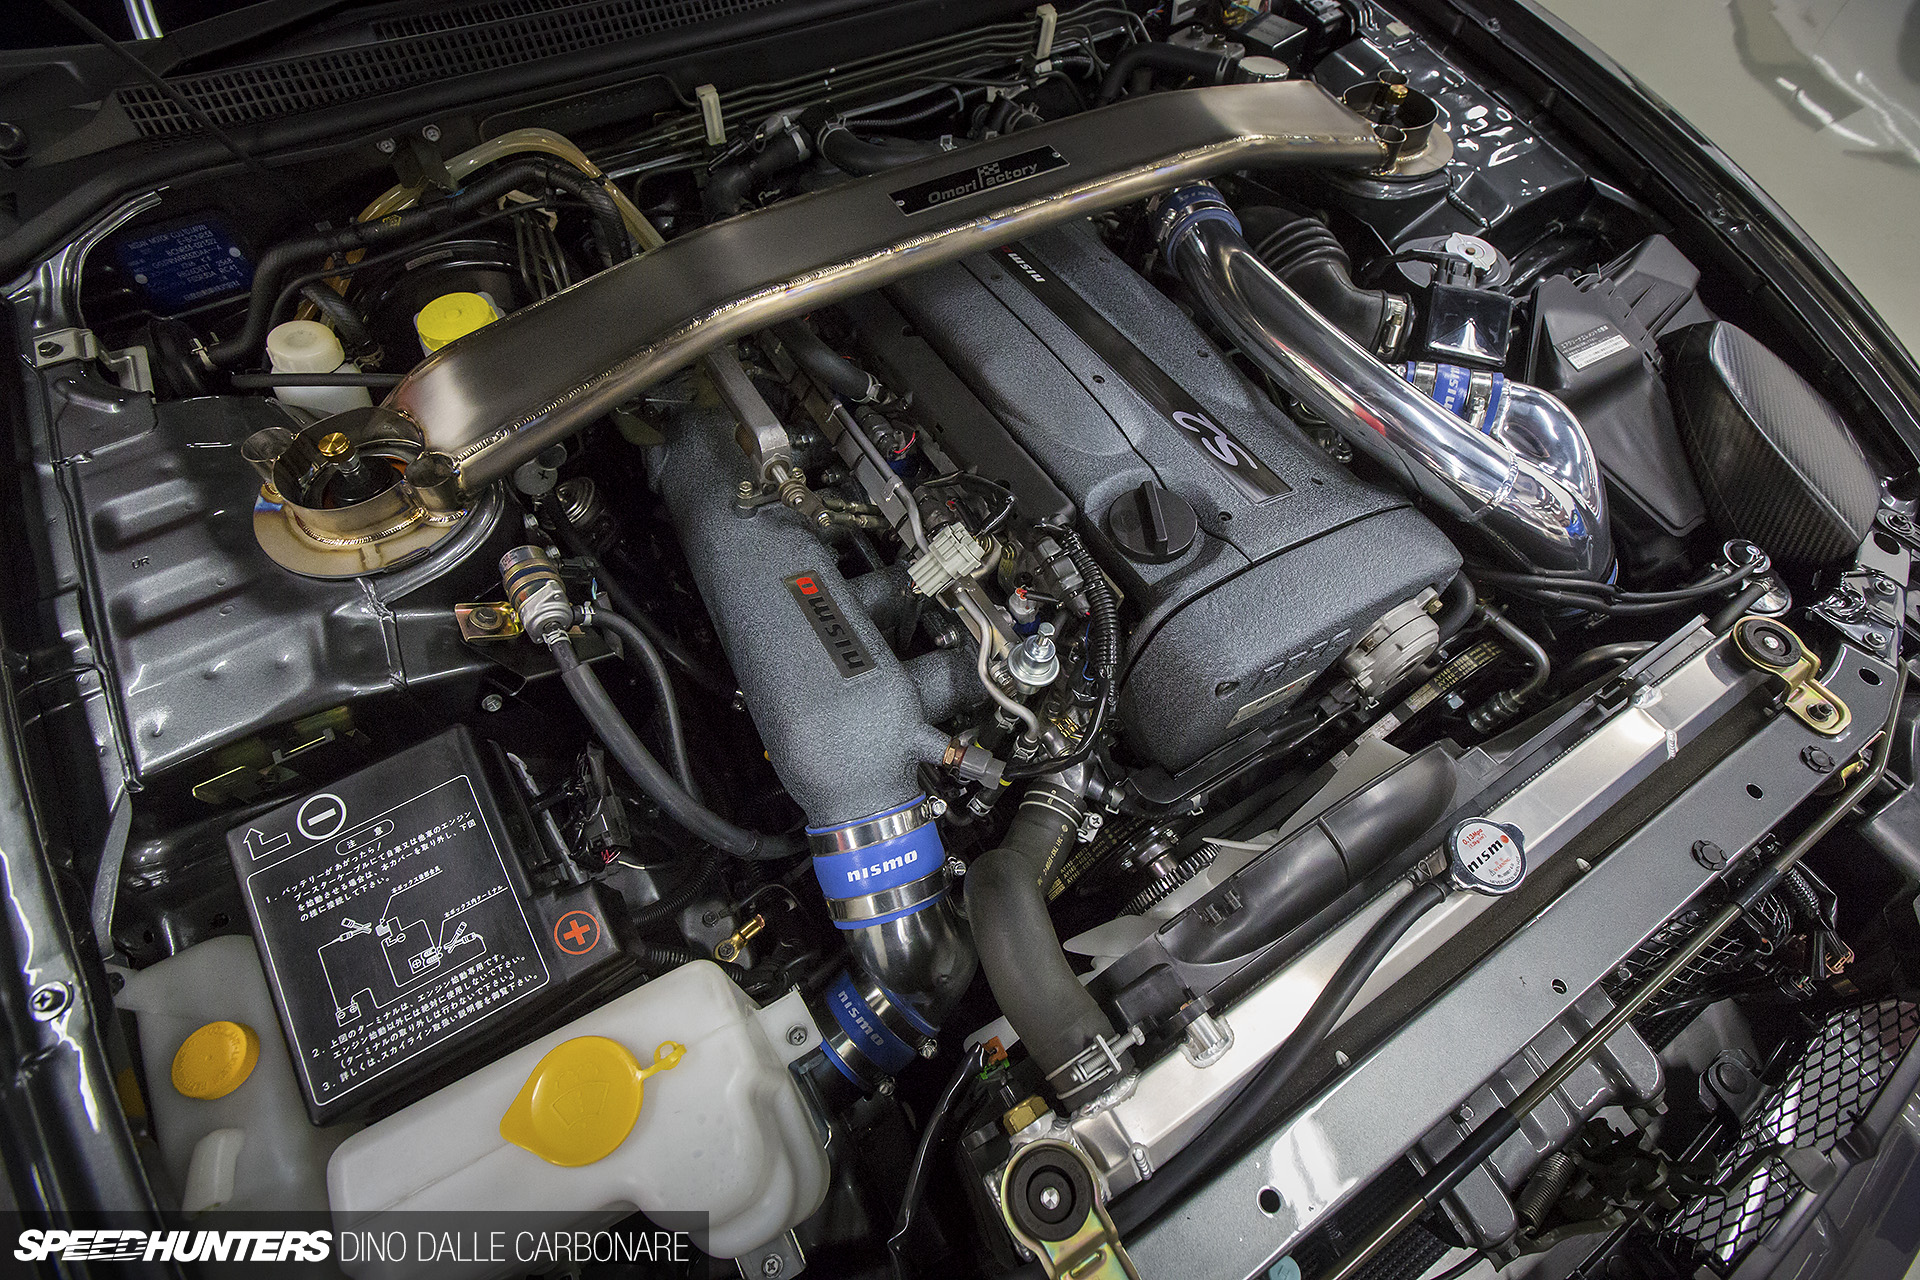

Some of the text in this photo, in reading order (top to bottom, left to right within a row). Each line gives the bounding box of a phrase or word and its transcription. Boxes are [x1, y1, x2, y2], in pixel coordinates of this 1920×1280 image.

[928, 162, 1039, 205] Omori Factory
[1001, 244, 1046, 283] nismo
[796, 577, 869, 669] nismo
[847, 850, 919, 883] nismo
[837, 989, 885, 1047] nismo
